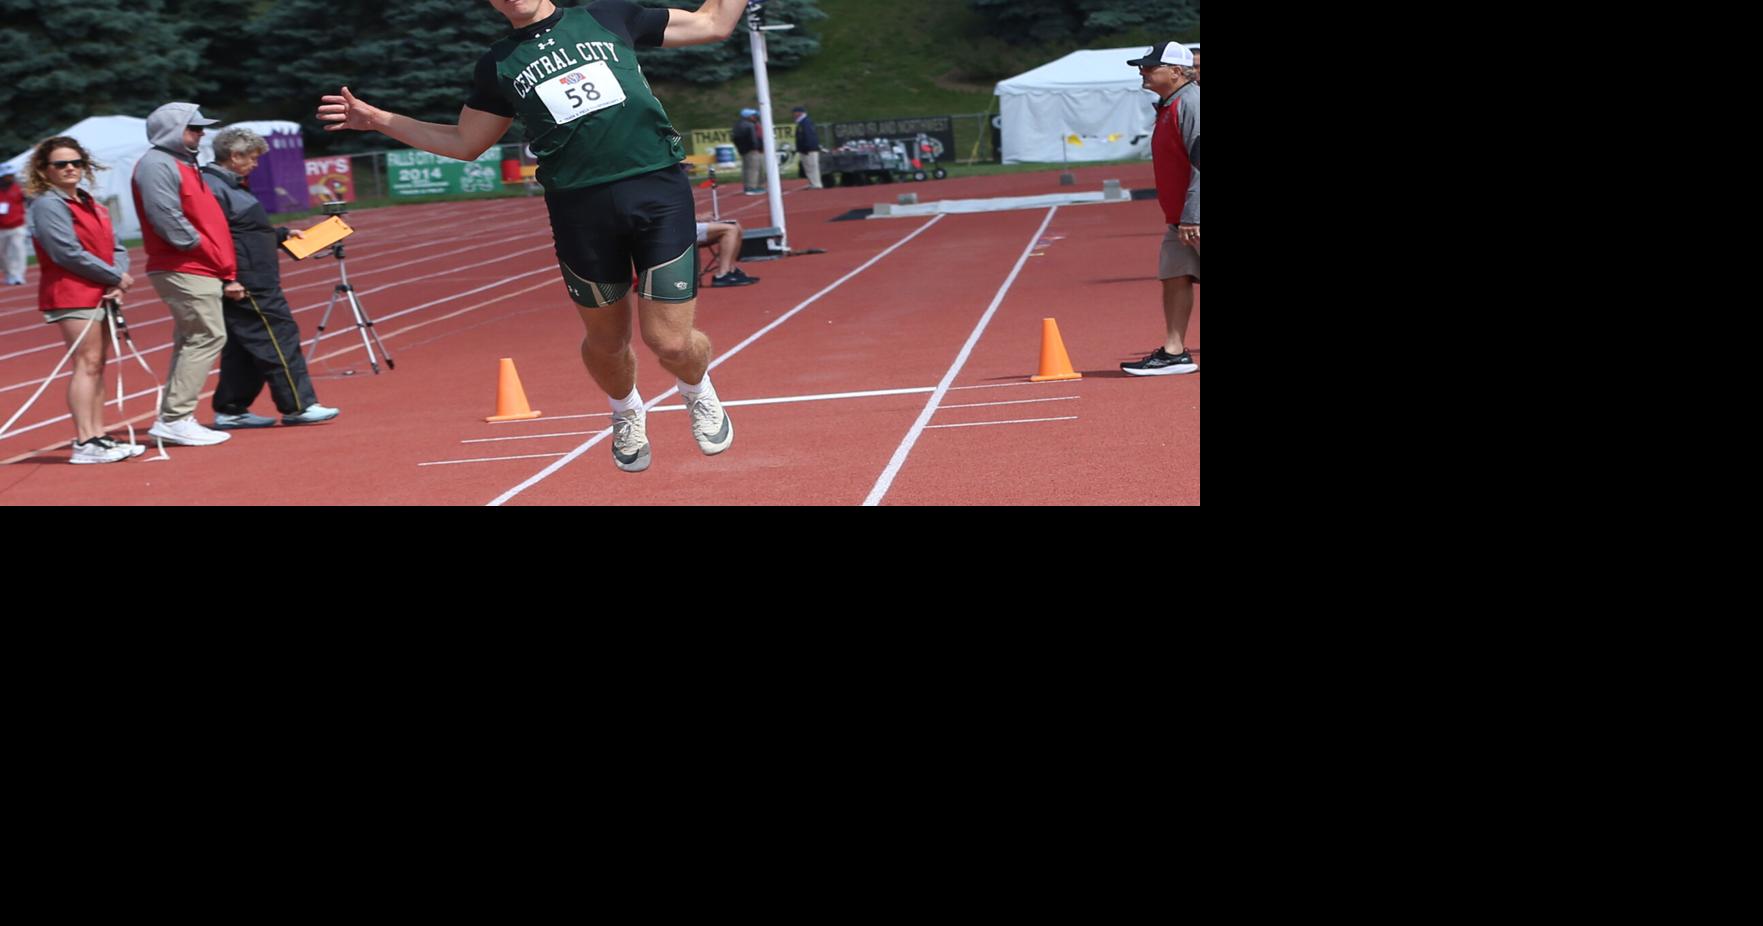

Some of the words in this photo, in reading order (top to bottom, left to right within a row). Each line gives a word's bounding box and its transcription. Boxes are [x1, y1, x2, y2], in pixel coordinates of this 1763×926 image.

[513, 47, 577, 99] CENTRAL
[575, 41, 619, 62] CITY
[564, 82, 602, 109] 58
[693, 130, 729, 143] THAY
[304, 158, 350, 176] RY'S
[398, 167, 442, 181] 2014
